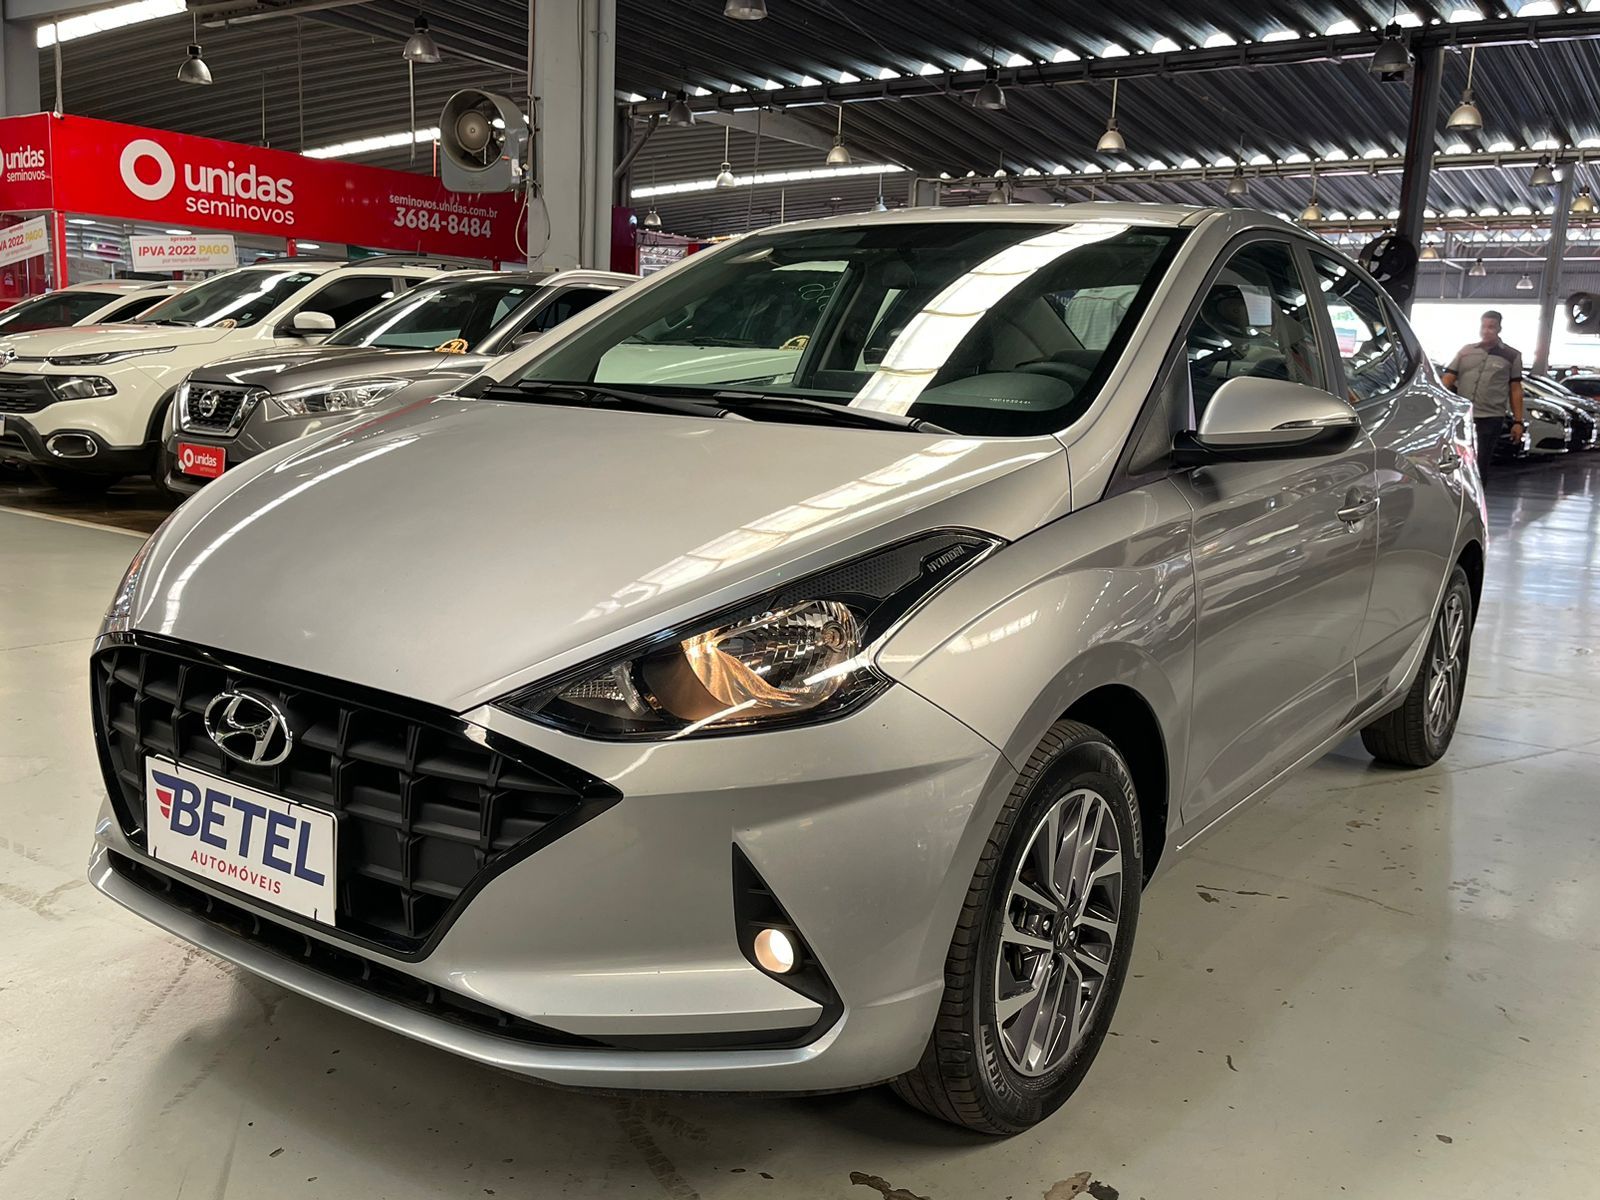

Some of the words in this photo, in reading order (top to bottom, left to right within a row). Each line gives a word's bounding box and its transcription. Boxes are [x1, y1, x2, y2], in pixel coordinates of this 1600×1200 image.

[6, 145, 45, 170] unidas
[6, 169, 46, 182] seminovos
[184, 160, 294, 205] unidas
[186, 196, 295, 225] seminovos
[389, 194, 498, 218] seminovos.unidas.com.br
[393, 206, 491, 238] 3684-8484
[8, 234, 24, 248] 2022
[138, 245, 165, 257] IPVA
[168, 245, 197, 256] 2022
[199, 244, 229, 255] PAGO
[194, 452, 217, 467] unidas
[926, 545, 965, 573] HYUNDAI
[152, 769, 325, 886] BETEL
[190, 851, 282, 895] AUTOMÓVEIS
